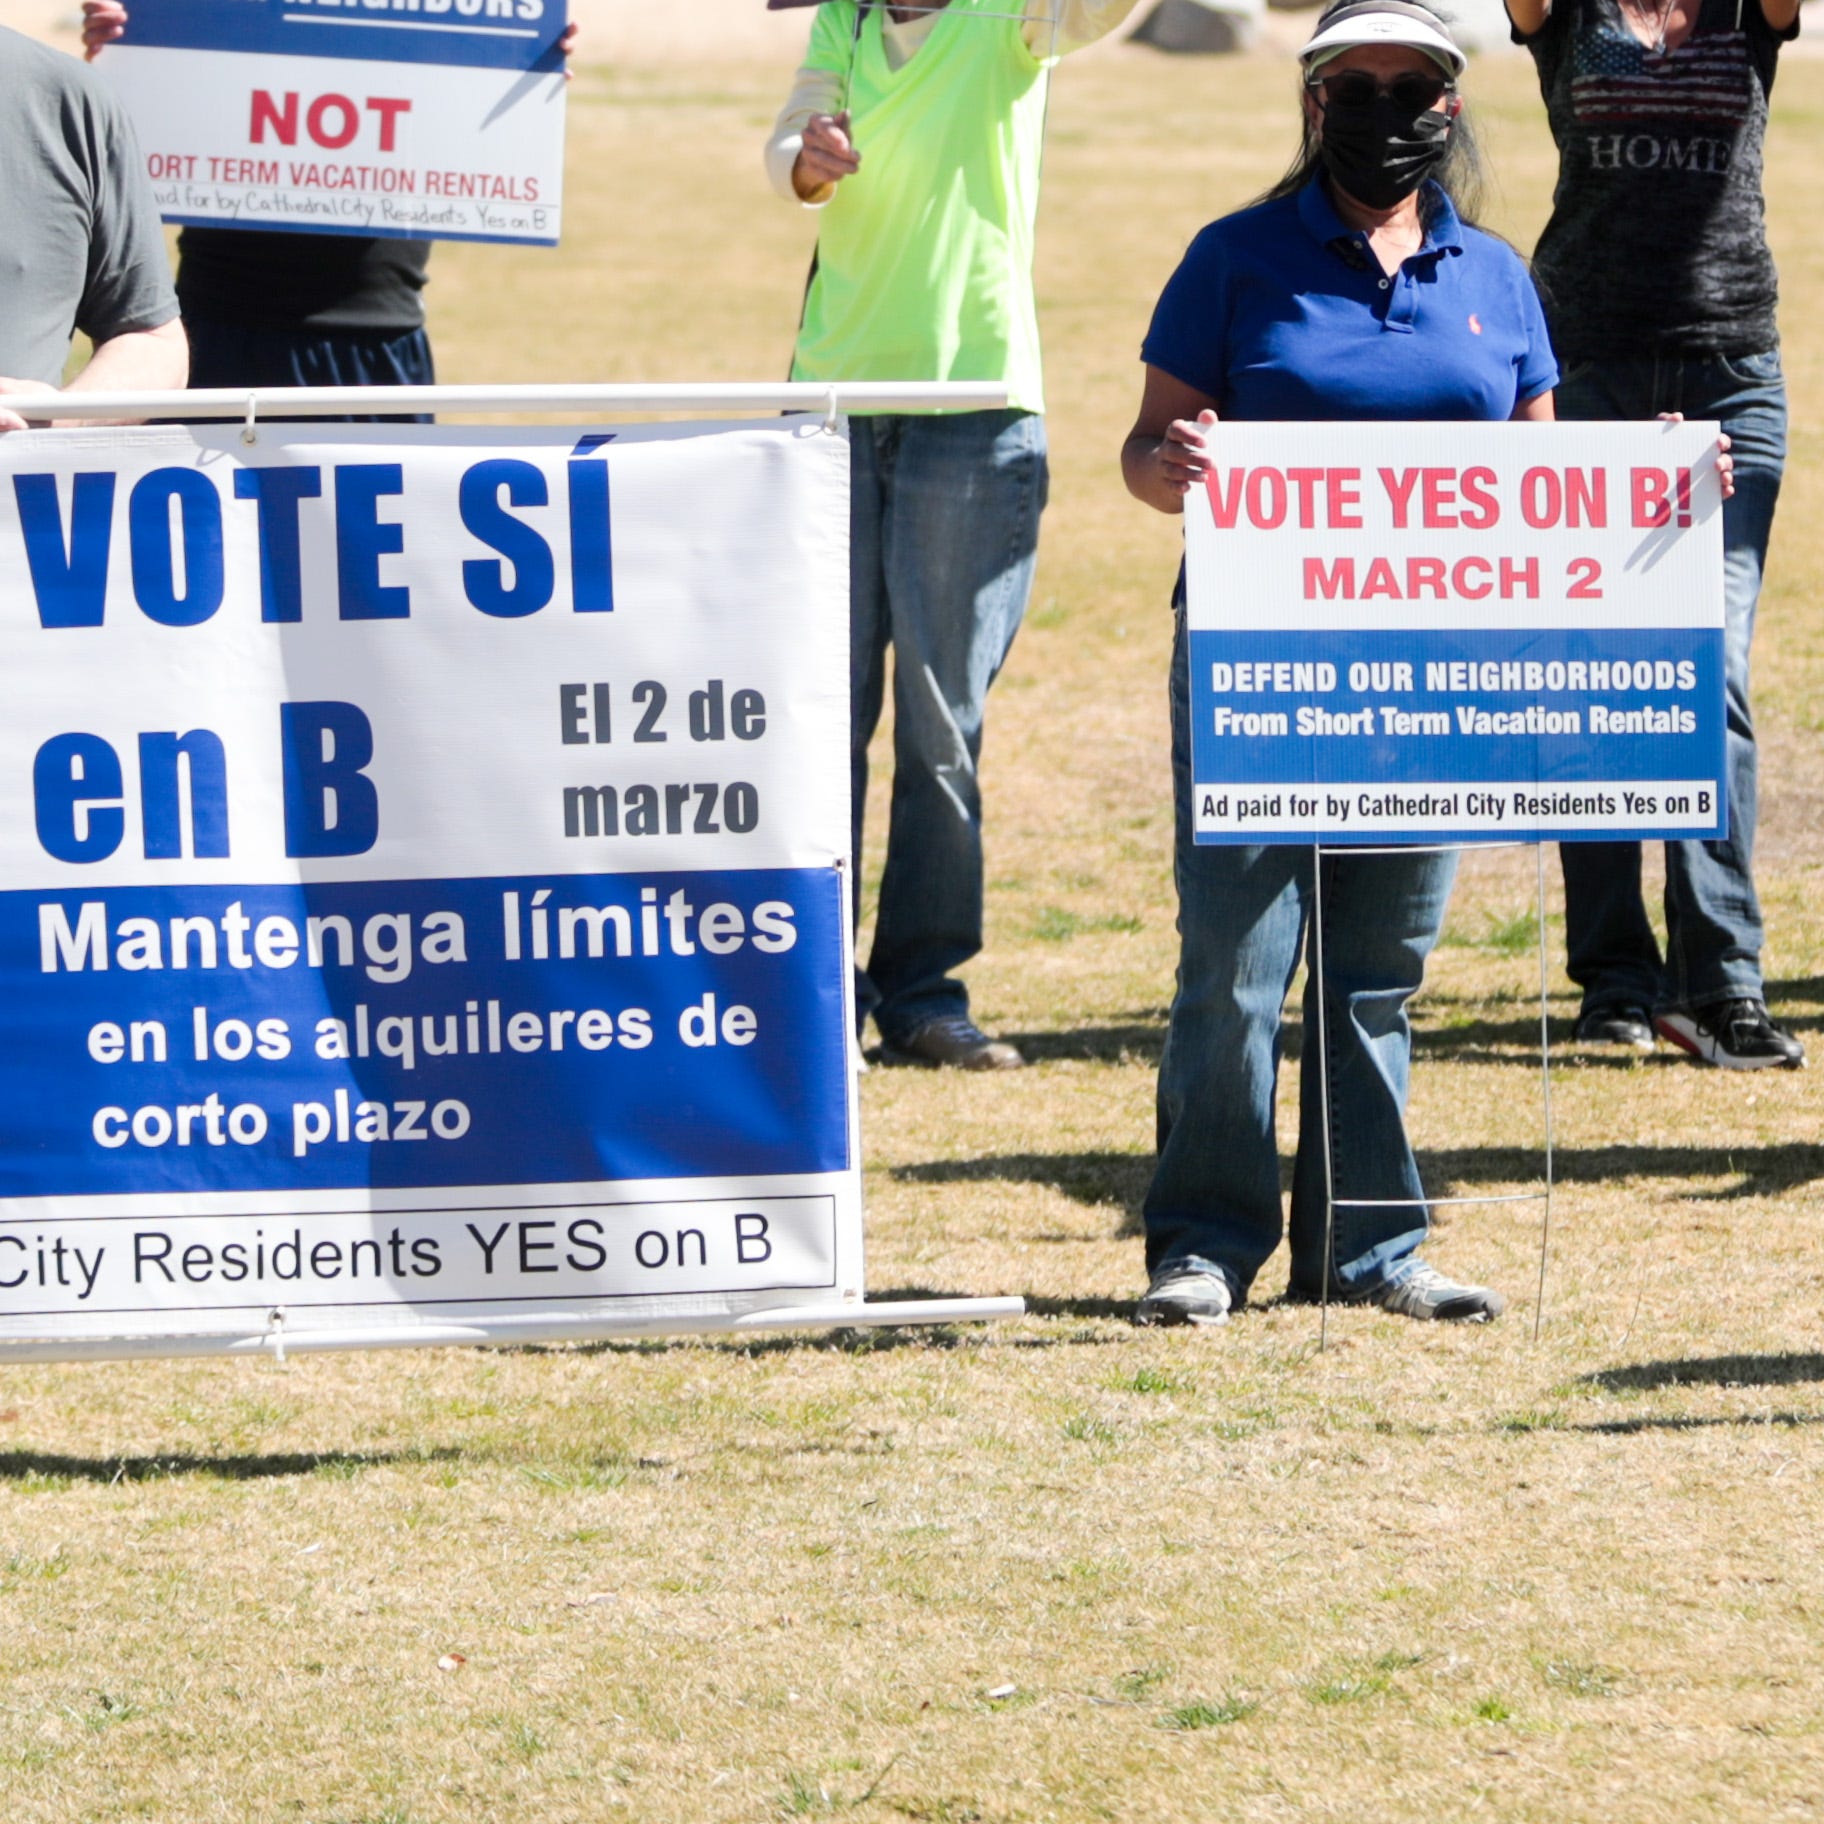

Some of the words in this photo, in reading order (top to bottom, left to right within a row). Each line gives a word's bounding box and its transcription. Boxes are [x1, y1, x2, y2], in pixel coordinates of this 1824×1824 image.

[1588, 134, 1731, 173] HOME
[12, 462, 411, 630] VOTE
[457, 434, 616, 619] SÍ
[1303, 557, 1540, 600] MARCH
[1565, 557, 1603, 599] 2
[1212, 662, 1337, 692] DEFEND
[1349, 661, 1413, 692] OUR
[1426, 659, 1697, 691] NEIGHBORHOODS
[559, 682, 611, 745] El
[631, 680, 668, 744] 2
[687, 679, 767, 742] de
[1214, 707, 1288, 736] From
[1296, 707, 1374, 736] Short
[1380, 706, 1450, 735] Term
[1456, 706, 1580, 734] Vacation
[1589, 705, 1697, 734] Rentals
[32, 727, 231, 866] en
[280, 699, 380, 861] B
[561, 780, 760, 839] marzo
[1202, 794, 1228, 818] Ad
[1237, 793, 1282, 821] paid
[1289, 794, 1319, 817] for
[1326, 794, 1351, 820] by
[1358, 792, 1459, 817] Cathedral
[1466, 792, 1506, 820] City
[1513, 790, 1616, 816] Residents
[1623, 790, 1657, 815] Yes
[1665, 795, 1690, 814] on
[1697, 791, 1711, 814] B
[38, 901, 468, 984] Mantenga
[502, 888, 798, 961] límites
[87, 1012, 168, 1066] en
[192, 1007, 292, 1063] los
[313, 998, 654, 1070] alquileres
[677, 992, 759, 1048] de
[92, 1094, 270, 1151] corto
[292, 1087, 473, 1158] plazo
[131, 1226, 443, 1285] Residents
[464, 1218, 607, 1276] YES
[634, 1219, 709, 1272] on
[733, 1212, 774, 1266] B
